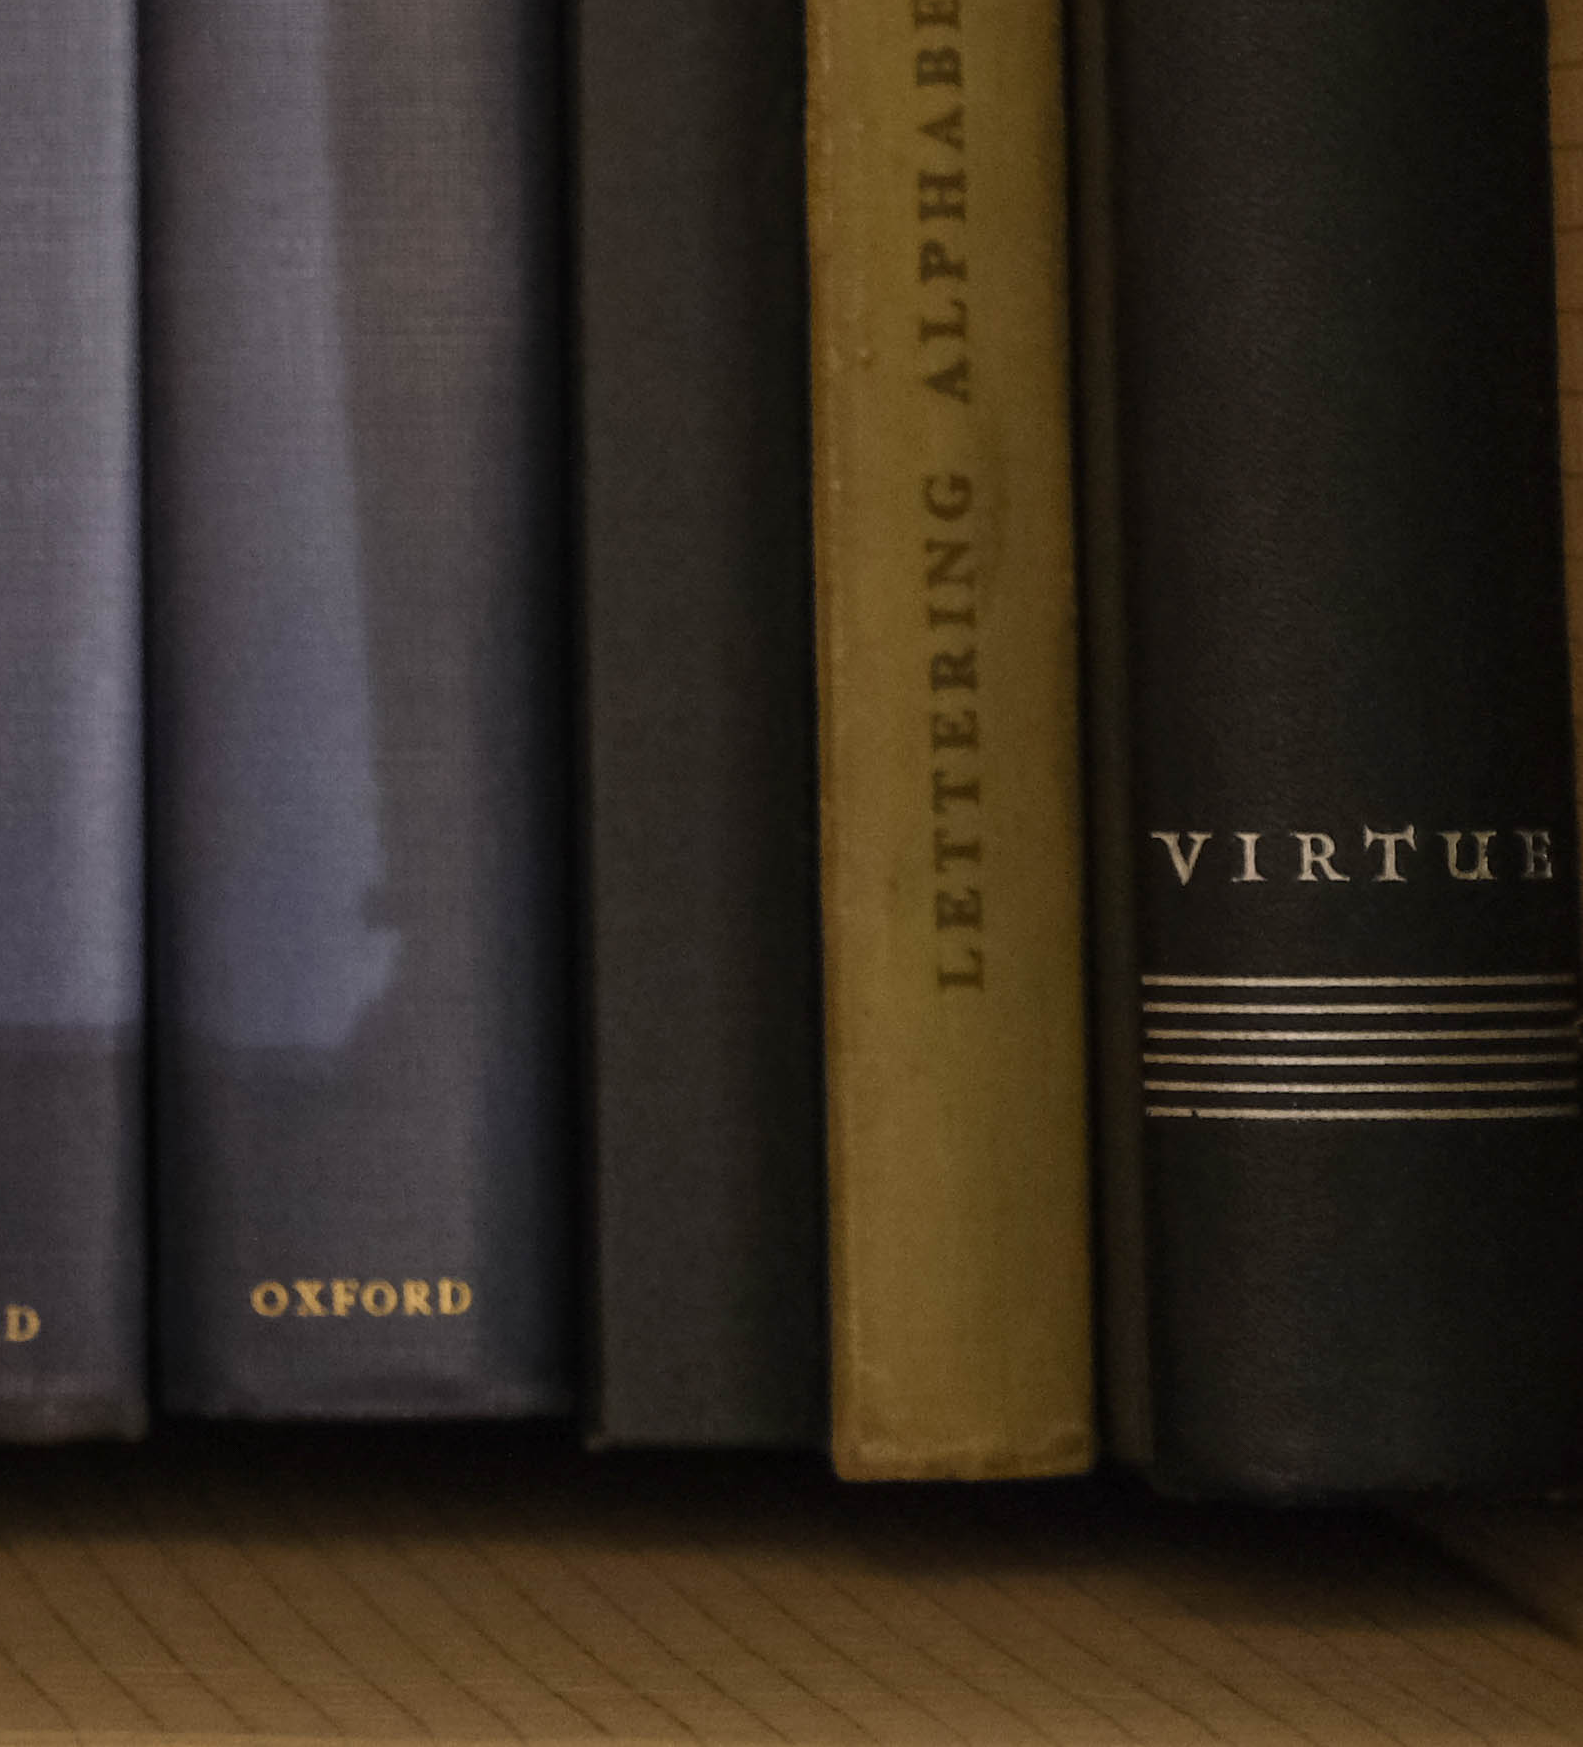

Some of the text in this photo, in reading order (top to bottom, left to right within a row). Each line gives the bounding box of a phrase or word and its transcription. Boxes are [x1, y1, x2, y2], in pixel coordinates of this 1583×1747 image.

[922, 471, 986, 994] LETTERING
[1149, 823, 1554, 886] VIRTUE
[250, 1277, 474, 1319] OXFORD
